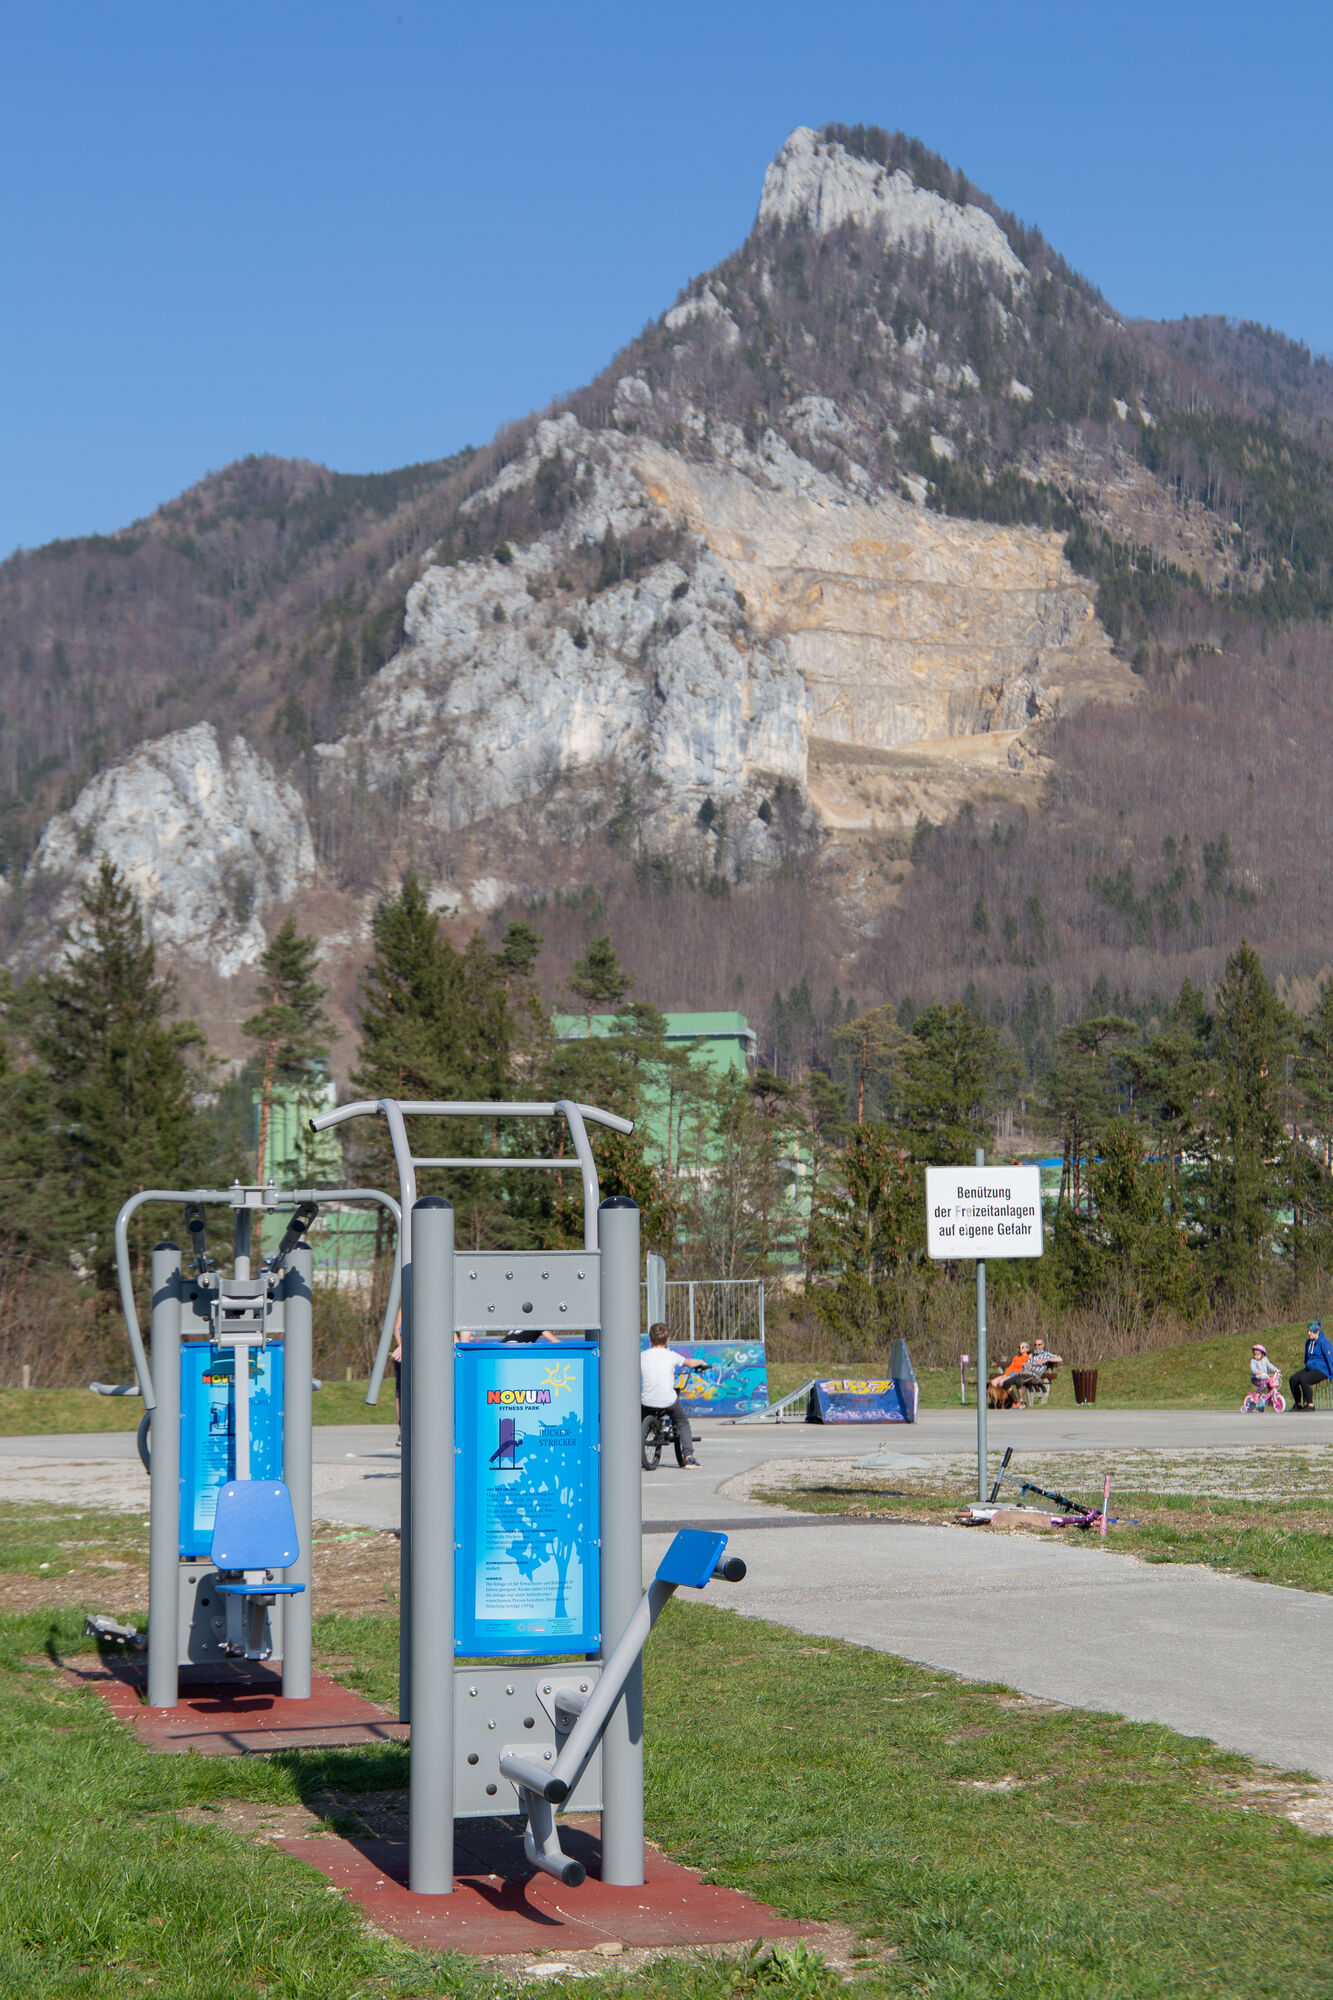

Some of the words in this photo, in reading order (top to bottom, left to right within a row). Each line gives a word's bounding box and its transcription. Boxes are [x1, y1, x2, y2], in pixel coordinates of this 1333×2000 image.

[957, 1186, 1011, 1200] Benützung
[934, 1206, 952, 1218] der
[955, 1204, 1035, 1218] Freizeitanlagen
[939, 1224, 956, 1236] auf
[959, 1224, 994, 1238] eigene
[997, 1223, 1032, 1235] Gefahr
[825, 1380, 893, 1394] 187
[487, 1389, 551, 1404] NOVUM
[539, 1438, 577, 1447] STRECKER
